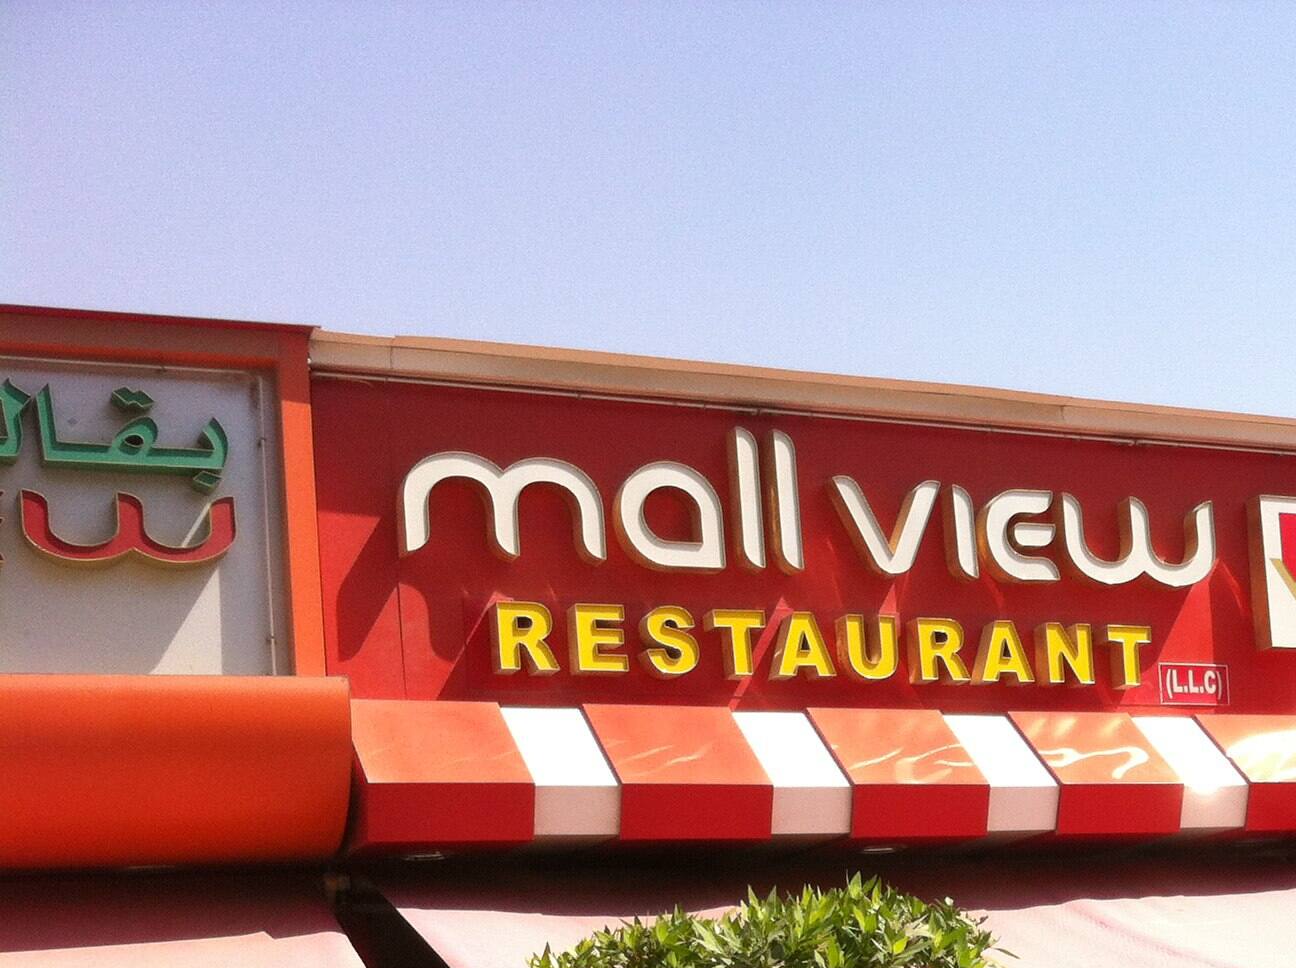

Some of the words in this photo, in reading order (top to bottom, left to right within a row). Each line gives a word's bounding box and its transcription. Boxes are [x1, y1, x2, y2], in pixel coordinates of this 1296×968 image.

[398, 425, 805, 574] mall
[492, 600, 1153, 691] RESTAURANT
[1166, 668, 1223, 700] (L.L.C)
